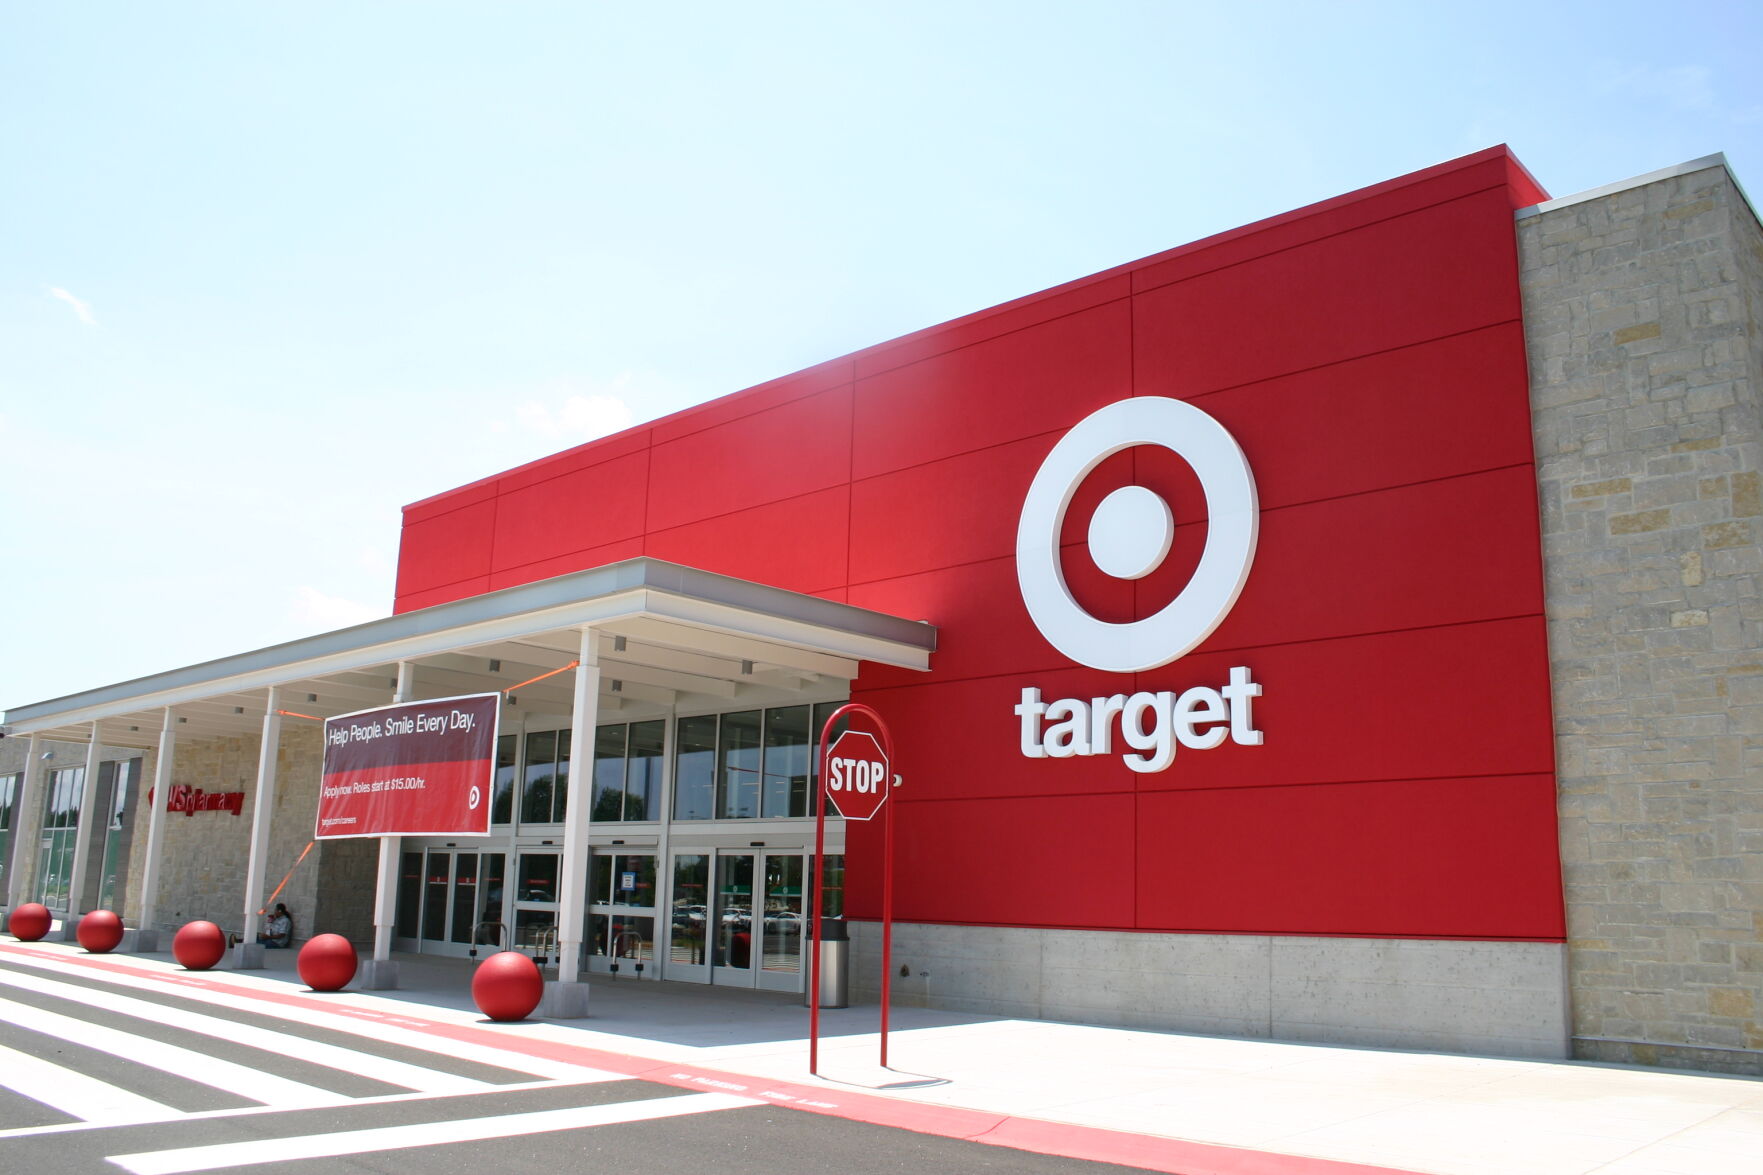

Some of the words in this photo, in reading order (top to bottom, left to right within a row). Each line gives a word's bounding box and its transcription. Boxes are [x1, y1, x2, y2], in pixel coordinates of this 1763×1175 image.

[329, 728, 348, 748] Help
[350, 721, 382, 744] People.
[385, 716, 414, 736] Smile
[416, 714, 448, 735] Every
[450, 710, 475, 733] Day.
[1014, 665, 1264, 773] target
[323, 785, 339, 799] Apply
[353, 782, 370, 794] Roles
[371, 781, 383, 792] start
[384, 780, 390, 791] at
[391, 777, 425, 790] $15.00/hr.
[830, 757, 884, 794] STOP
